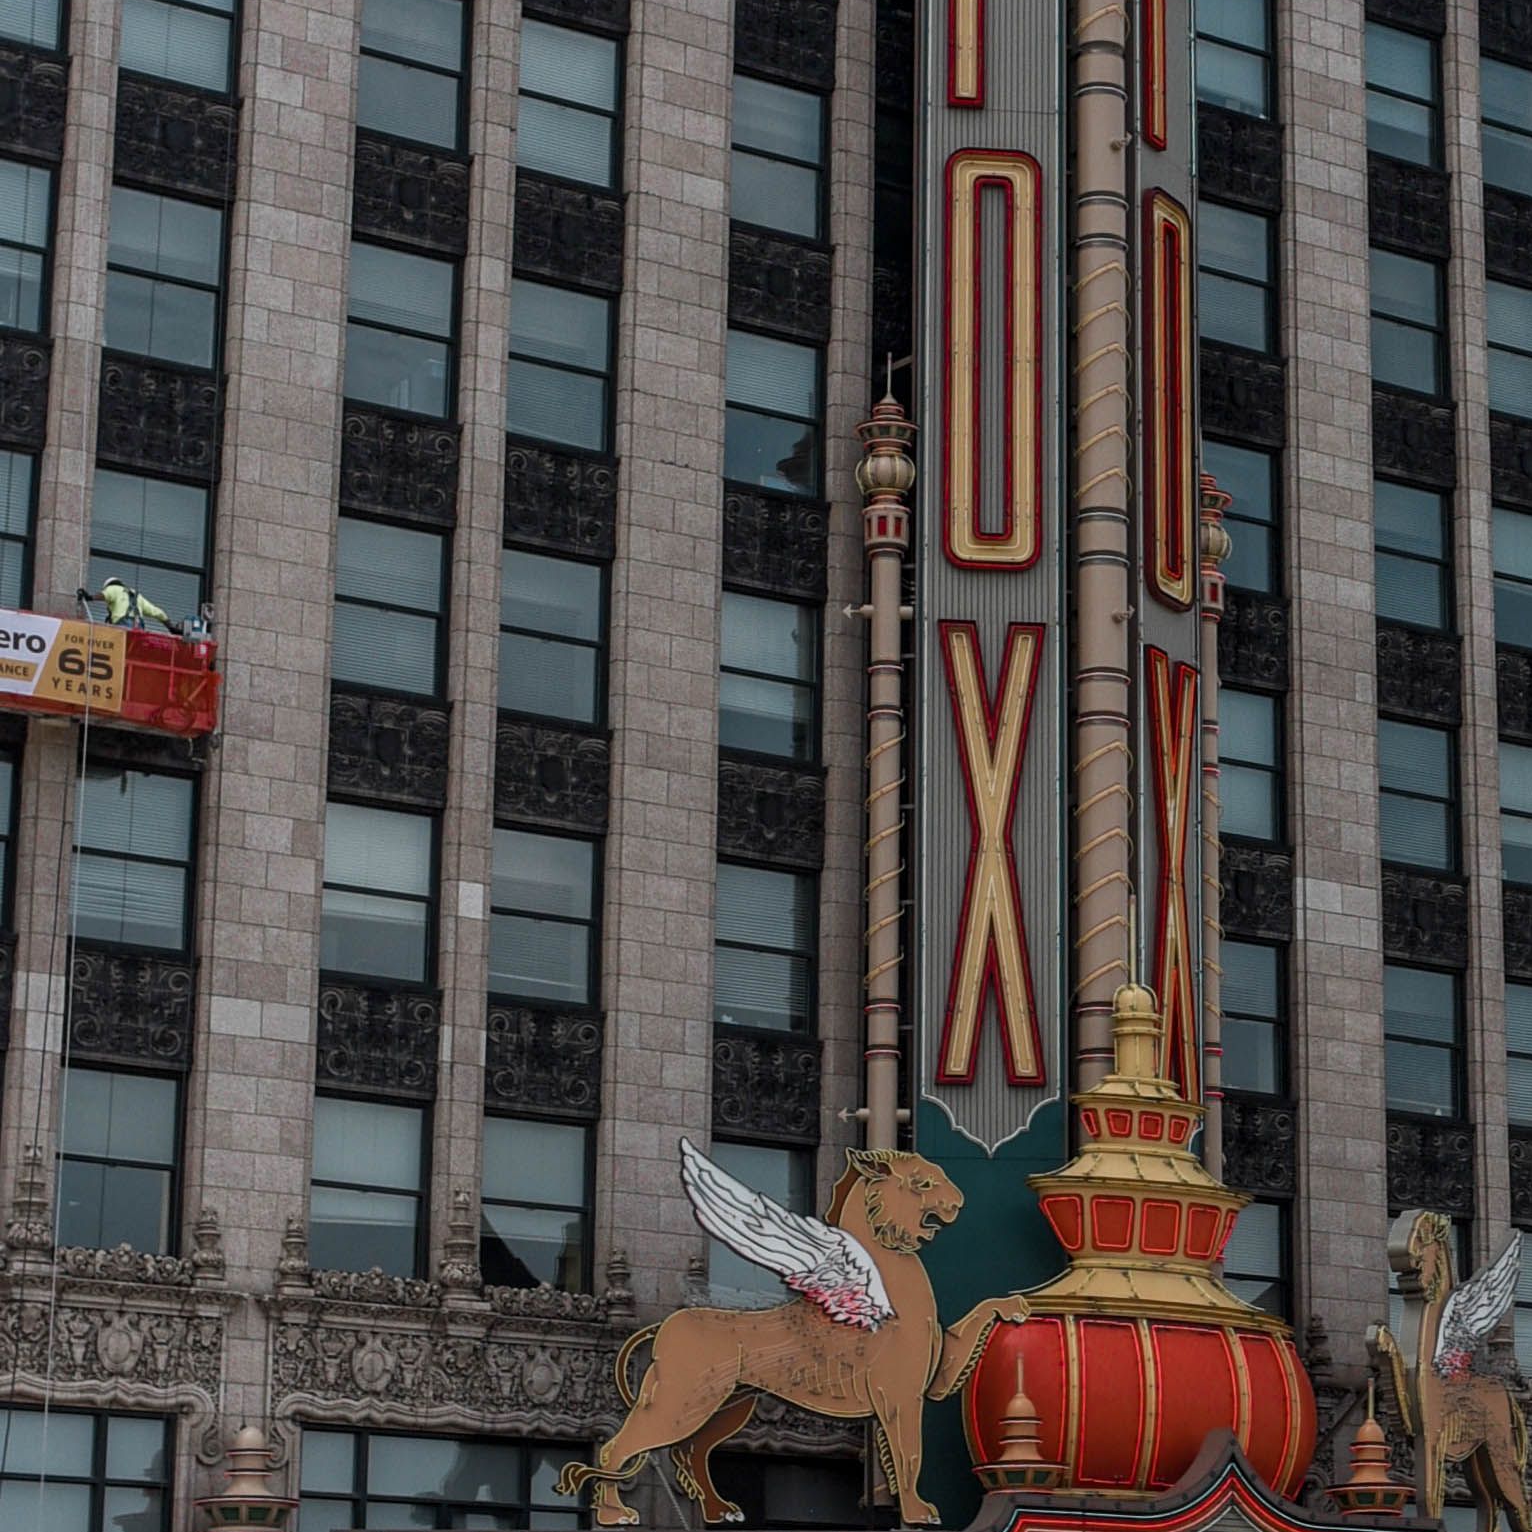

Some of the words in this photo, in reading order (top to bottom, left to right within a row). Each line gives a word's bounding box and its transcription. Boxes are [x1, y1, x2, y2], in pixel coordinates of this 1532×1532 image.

[65, 634, 84, 645] FOR
[88, 638, 114, 650] OVER
[59, 648, 113, 681] 65
[52, 677, 113, 700] YEARS
